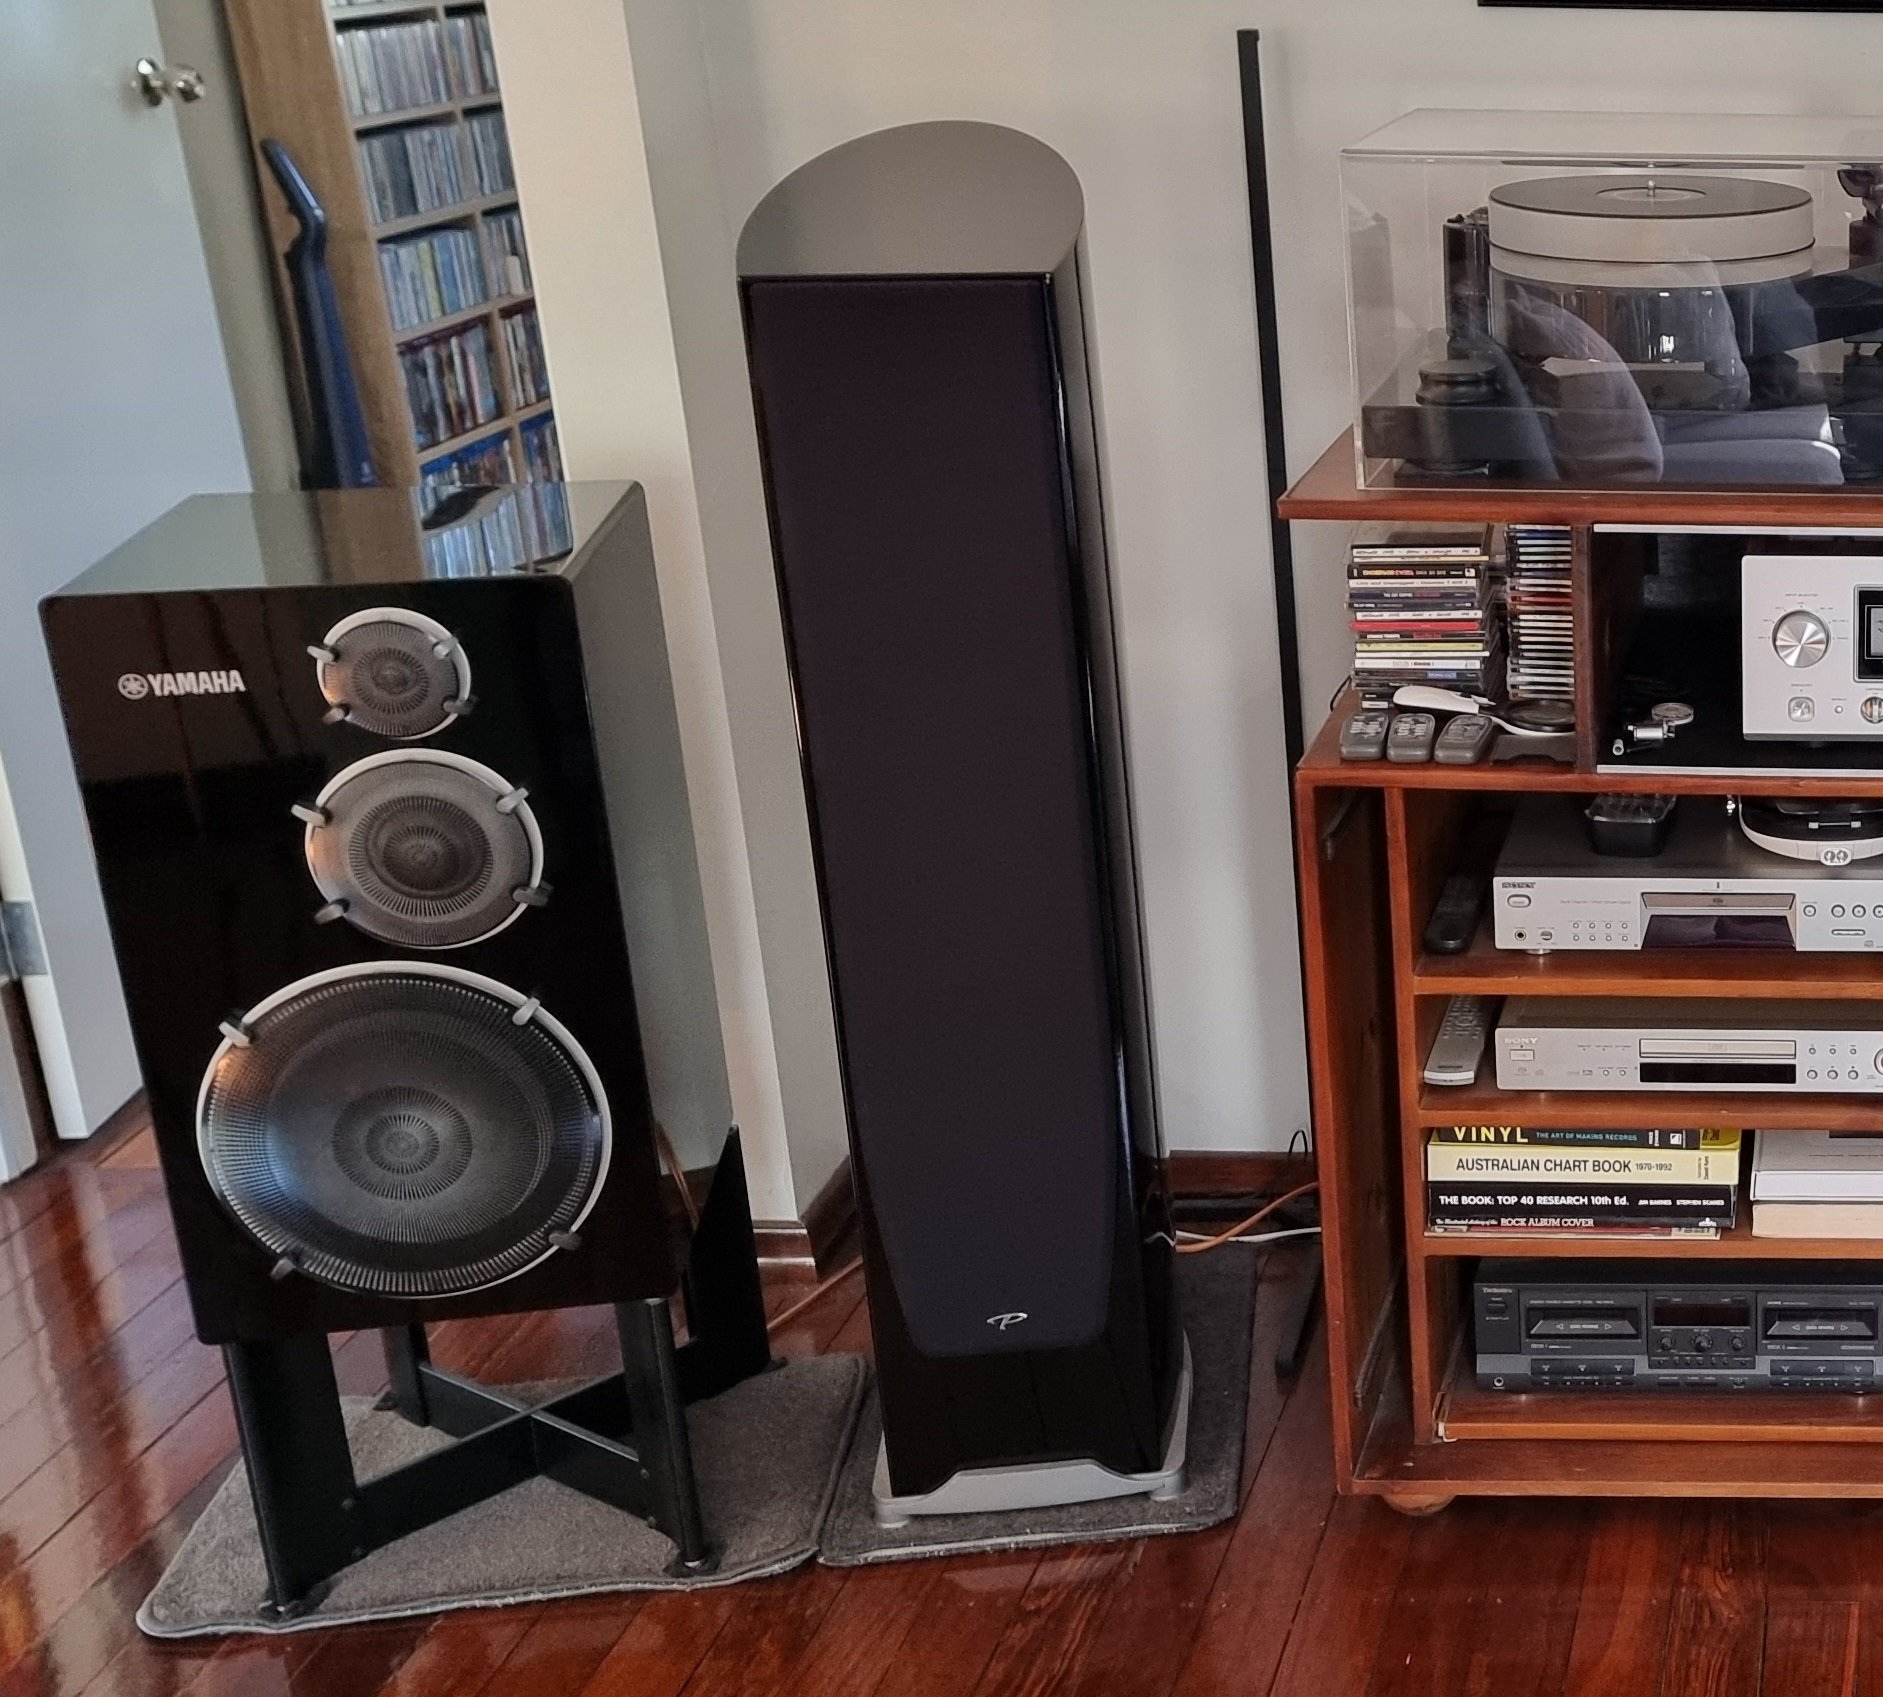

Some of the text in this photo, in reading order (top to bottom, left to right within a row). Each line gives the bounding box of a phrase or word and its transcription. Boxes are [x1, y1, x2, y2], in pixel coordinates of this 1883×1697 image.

[147, 669, 246, 696] YAMAHA
[1453, 1126, 1529, 1143] VINYL
[1456, 1158, 1673, 1173] AUSTRALIAN CHART BOOK 1970-1992
[1439, 1195, 1630, 1206] THE BOOK: TOP 40 RESEARCH 10th Ed.
[1500, 1217, 1527, 1227] ROCK
[1528, 1217, 1560, 1227] ALBUM
[1561, 1217, 1595, 1227] COVER
